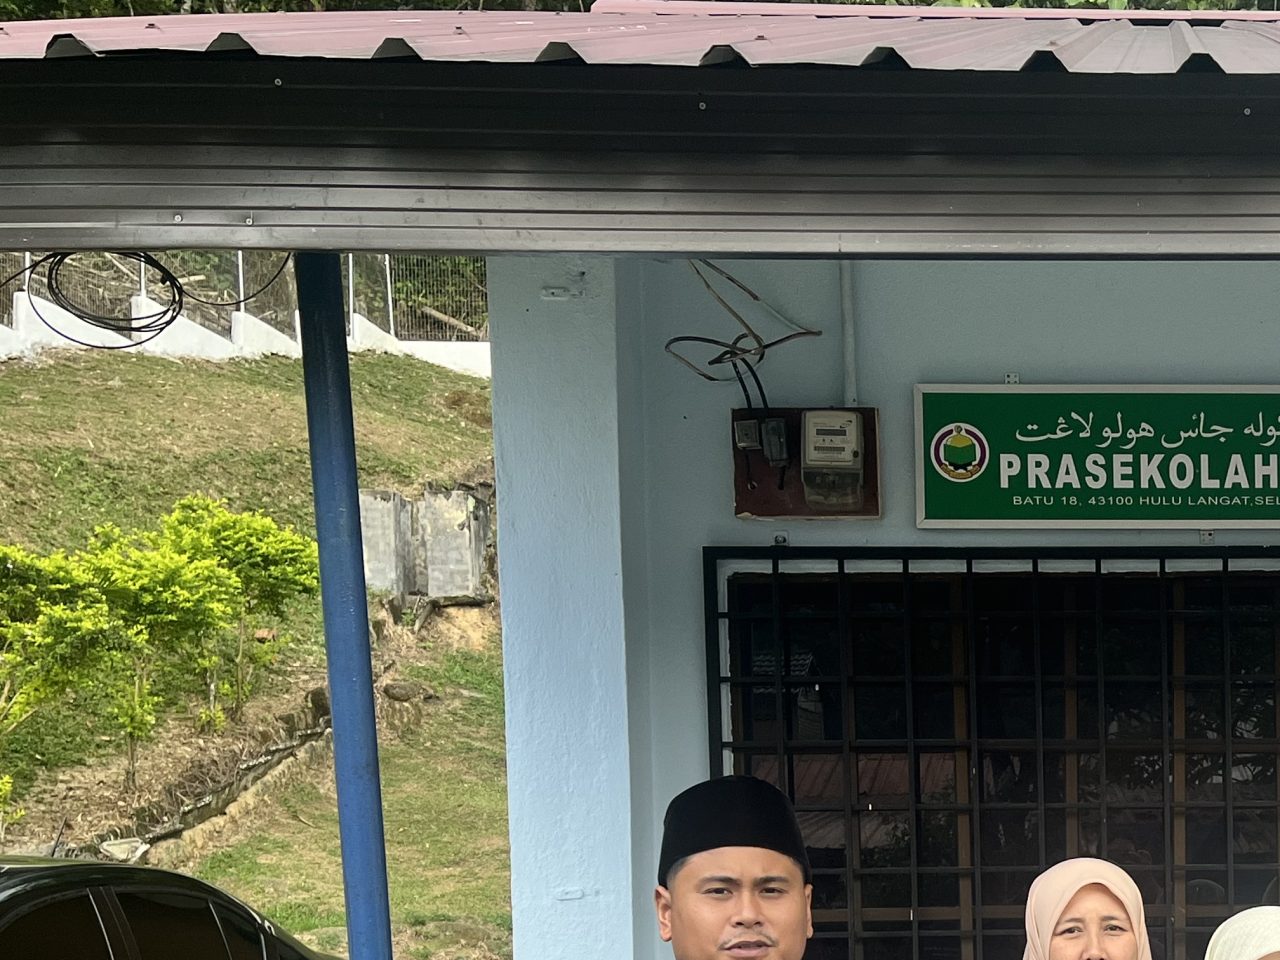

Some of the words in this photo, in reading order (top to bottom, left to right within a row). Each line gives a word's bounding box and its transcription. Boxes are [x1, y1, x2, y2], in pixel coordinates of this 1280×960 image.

[1000, 453, 1279, 489] PRASEKOLAH
[1013, 496, 1054, 505] BATU
[1061, 496, 1082, 507] 18,
[1088, 496, 1134, 505] 43100
[1139, 496, 1182, 505] HULU
